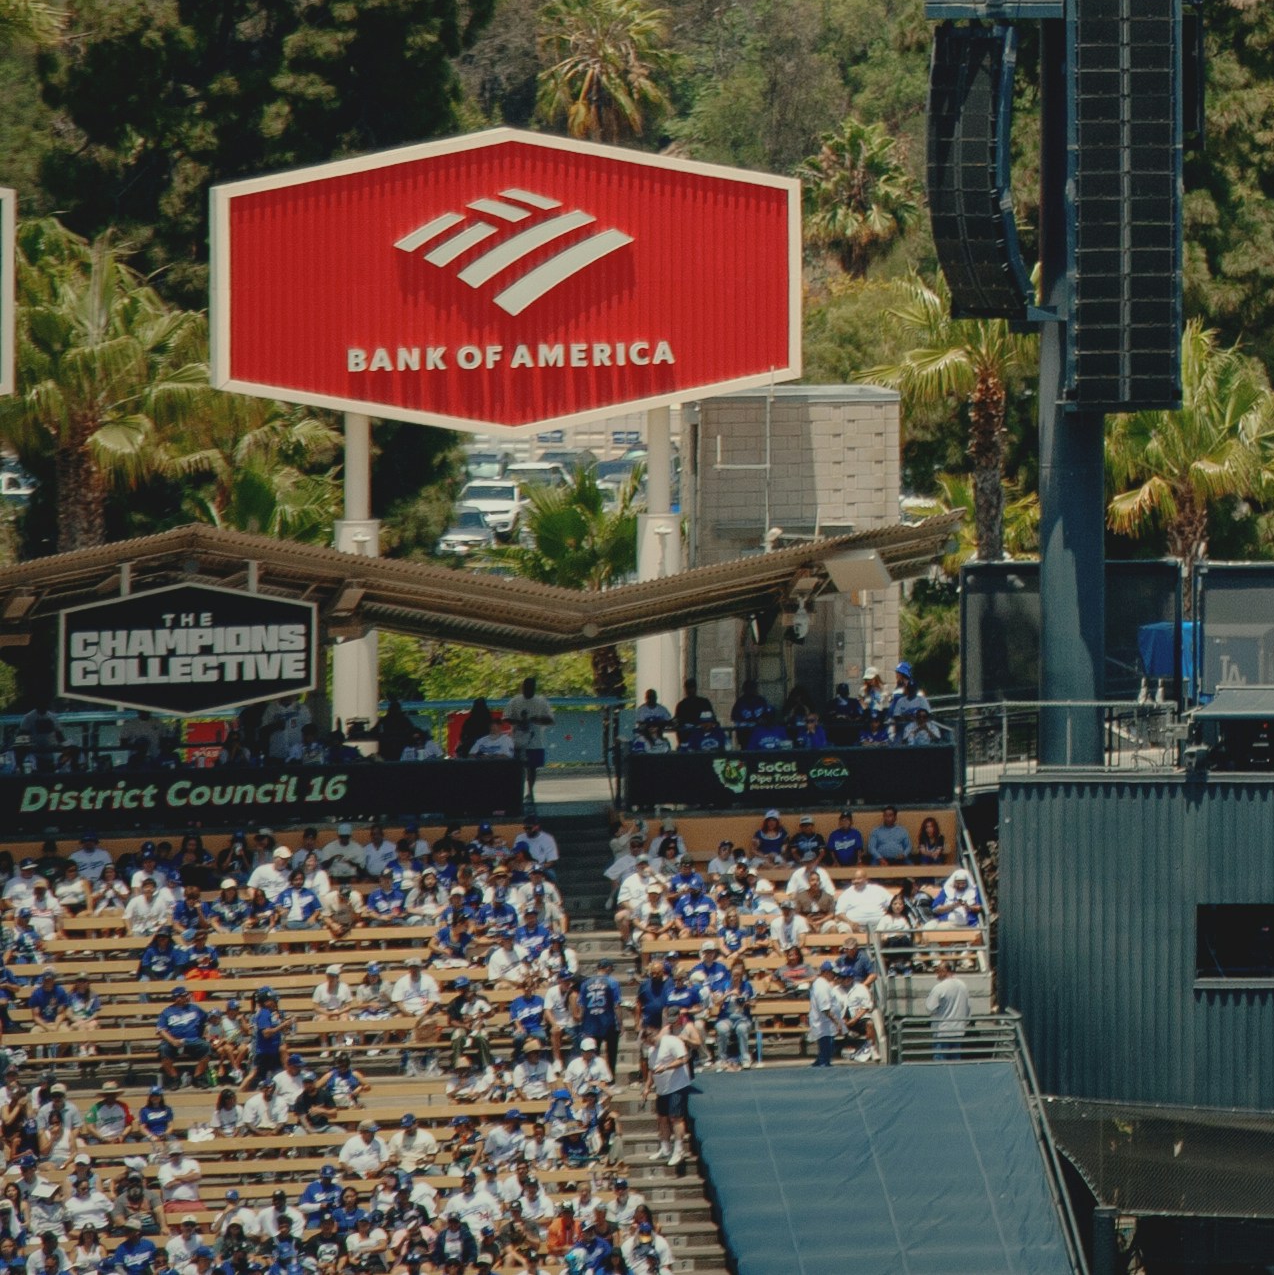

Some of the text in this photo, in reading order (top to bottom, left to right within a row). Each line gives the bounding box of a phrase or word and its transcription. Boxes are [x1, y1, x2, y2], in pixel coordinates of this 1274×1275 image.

[346, 340, 676, 372] BANK OF AMERICA
[161, 612, 214, 627] THE
[70, 623, 306, 659] CHAMPIONS
[70, 651, 307, 687] COLLECTIVE
[758, 762, 797, 773] SoCal
[809, 768, 849, 779] CPMCA
[749, 773, 808, 784] Pipe Trades
[20, 774, 349, 813] District Council 16
[585, 991, 606, 1008] 25
